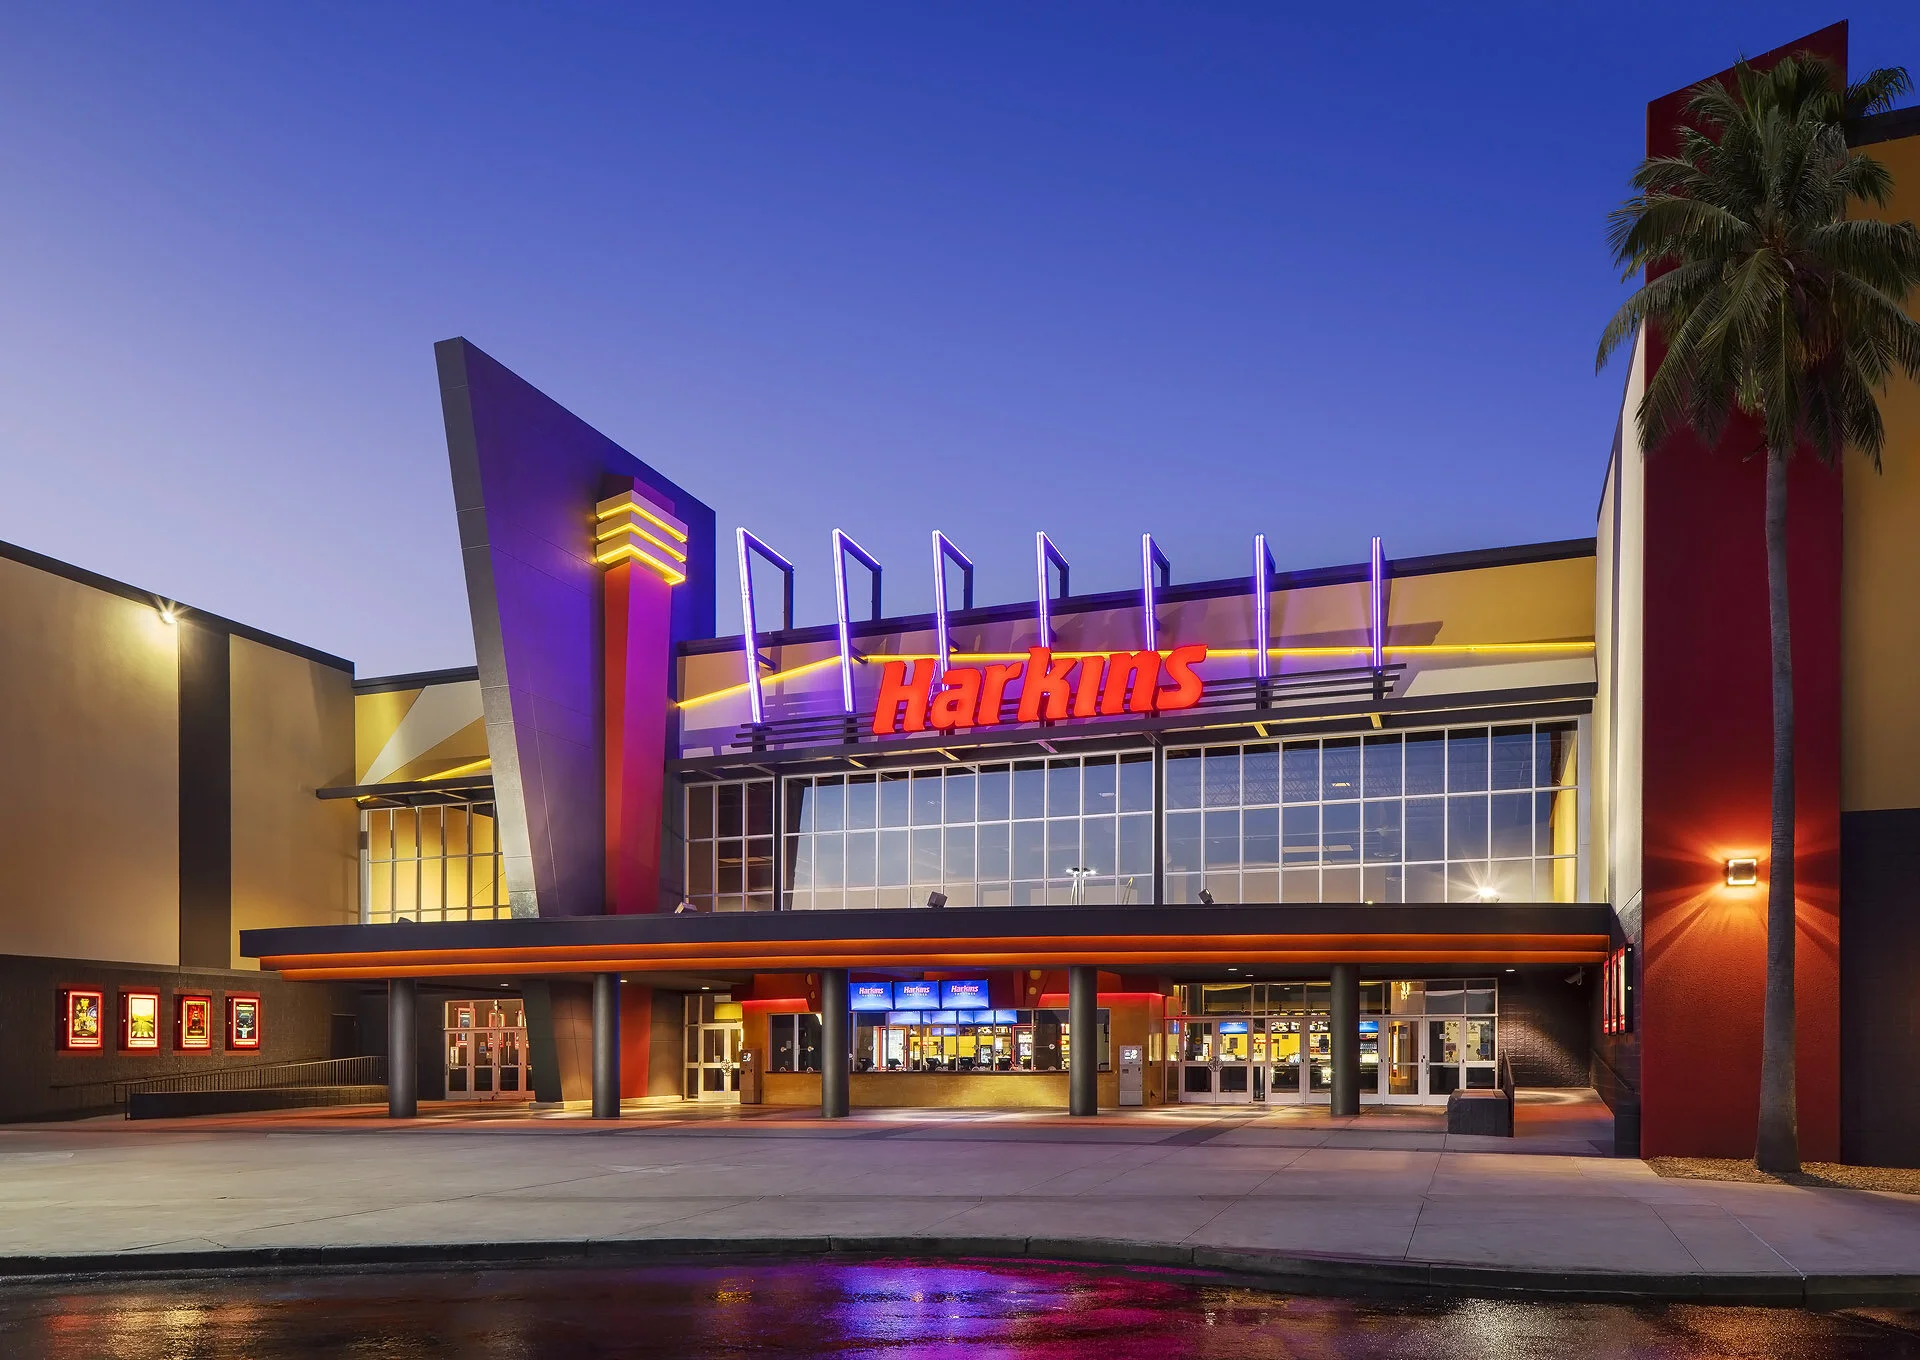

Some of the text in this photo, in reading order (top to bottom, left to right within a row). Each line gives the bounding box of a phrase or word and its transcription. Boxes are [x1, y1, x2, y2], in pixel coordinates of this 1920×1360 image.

[872, 644, 1208, 735] Harkins
[859, 987, 884, 995] Harkins
[903, 986, 930, 994] Harkins
[951, 985, 979, 993] Harkins
